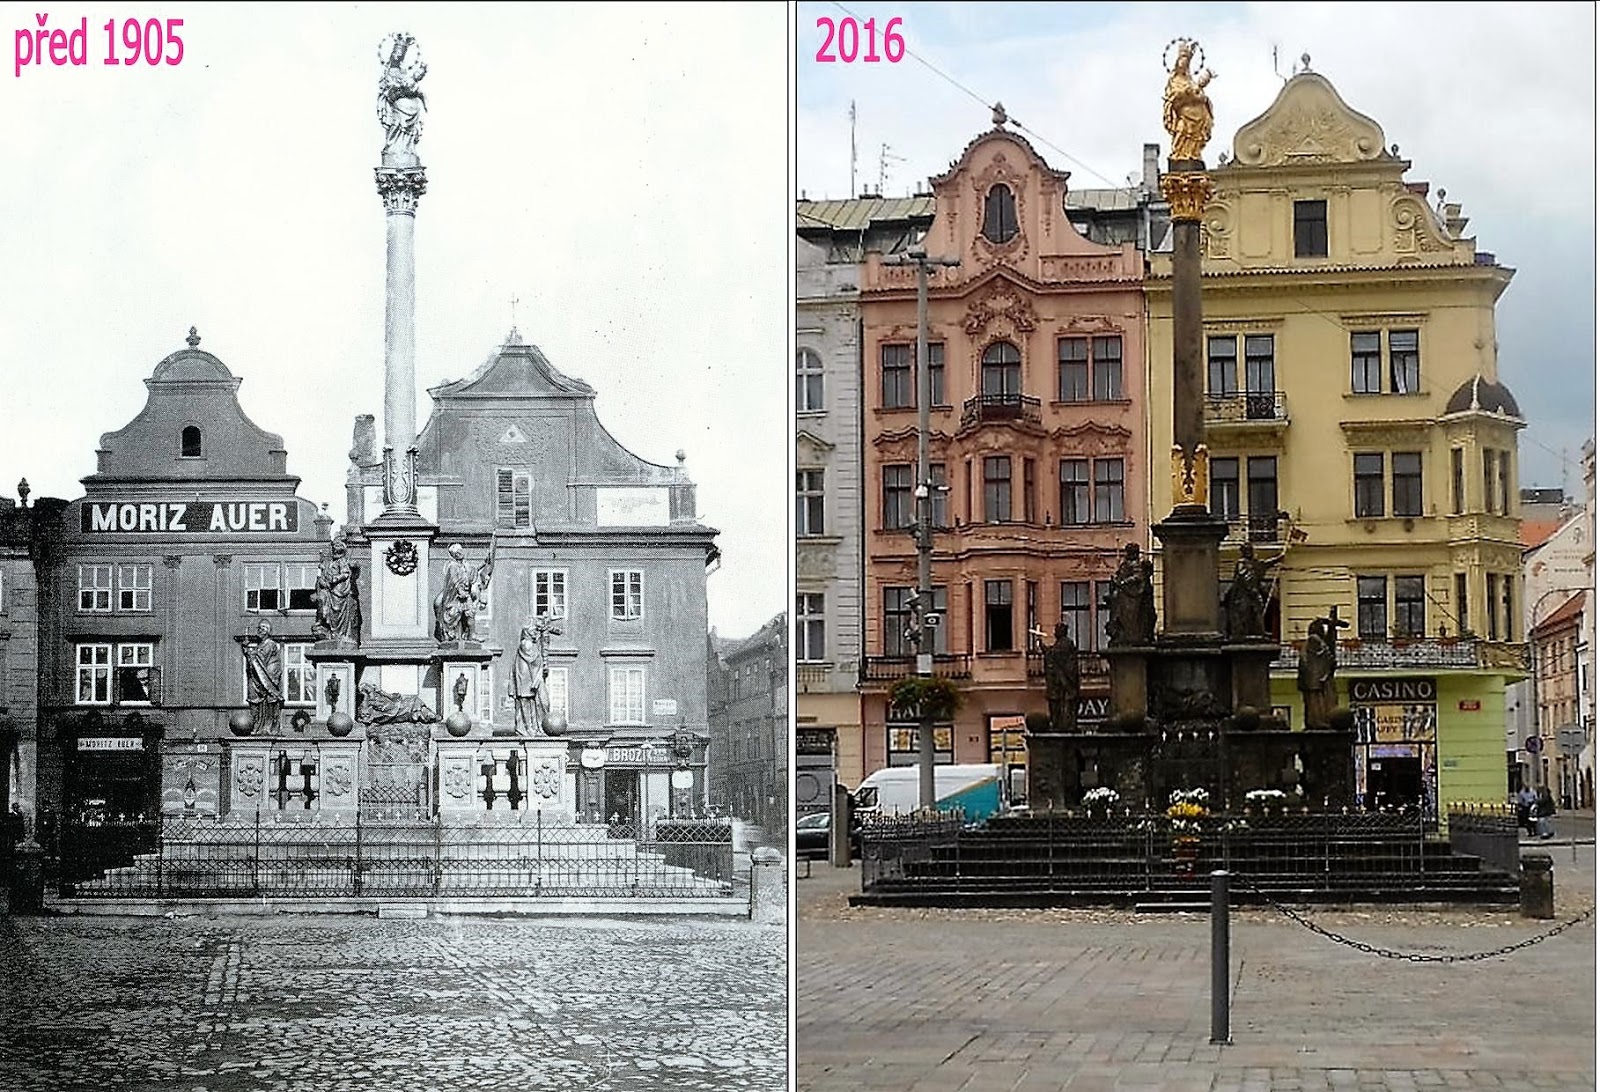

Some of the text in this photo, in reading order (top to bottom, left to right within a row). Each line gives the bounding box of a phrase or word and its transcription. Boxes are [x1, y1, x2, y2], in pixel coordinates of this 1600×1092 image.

[91, 503, 288, 532] MORIZ AUER
[1354, 681, 1432, 699] CASINO
